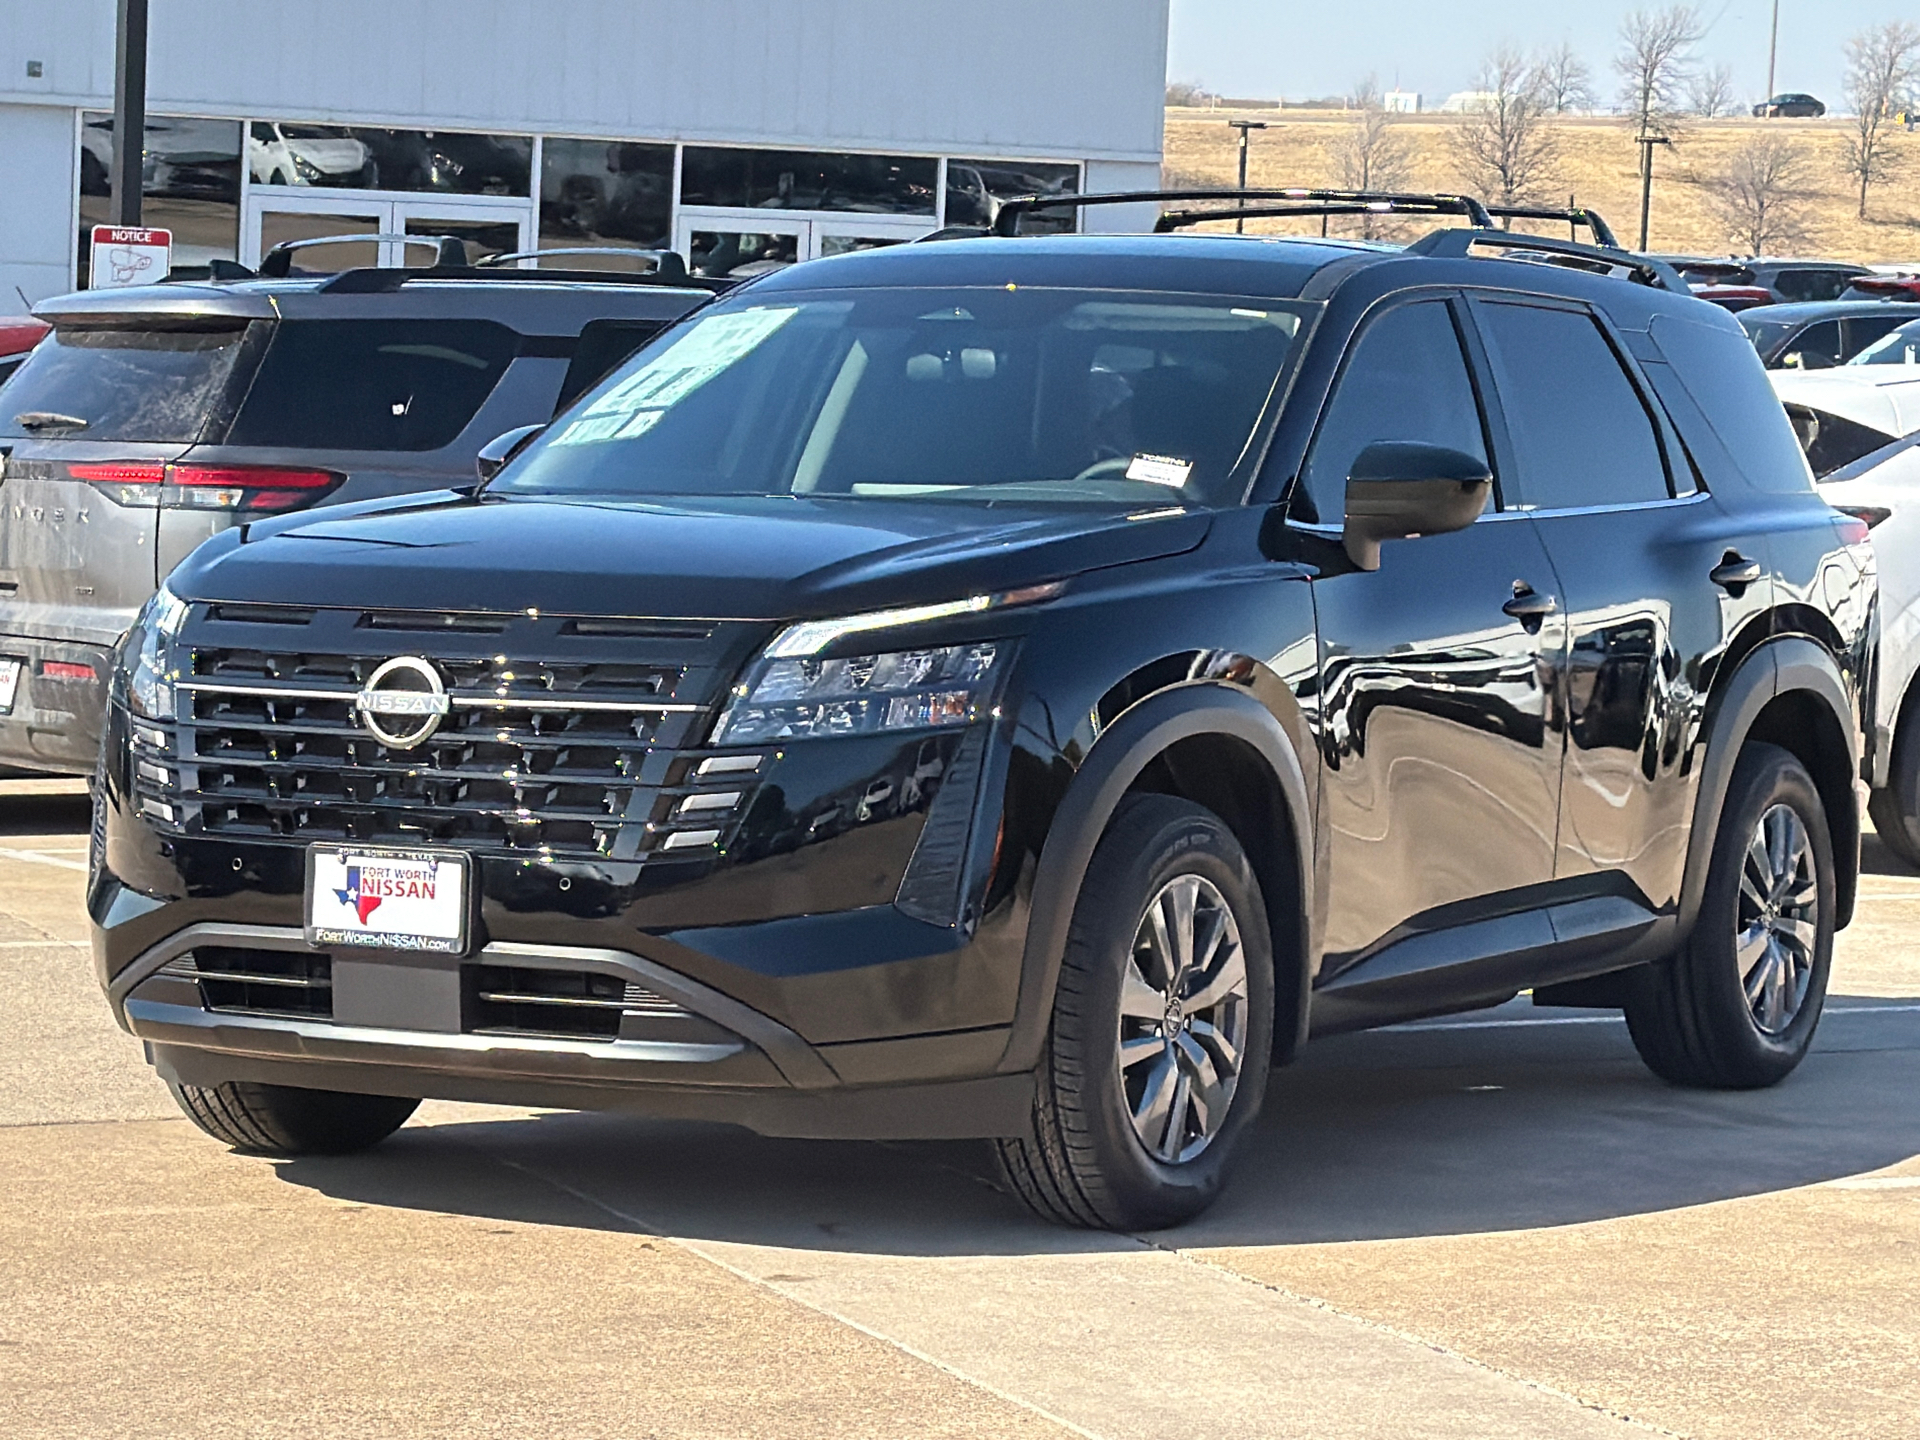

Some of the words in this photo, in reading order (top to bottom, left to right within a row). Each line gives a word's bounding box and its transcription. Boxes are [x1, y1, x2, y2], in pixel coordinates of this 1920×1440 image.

[111, 230, 152, 243] NOTICE
[360, 694, 446, 713] NISSAN
[362, 866, 391, 878] FORT
[394, 868, 436, 881] WORTH
[362, 877, 436, 900] NISSAN
